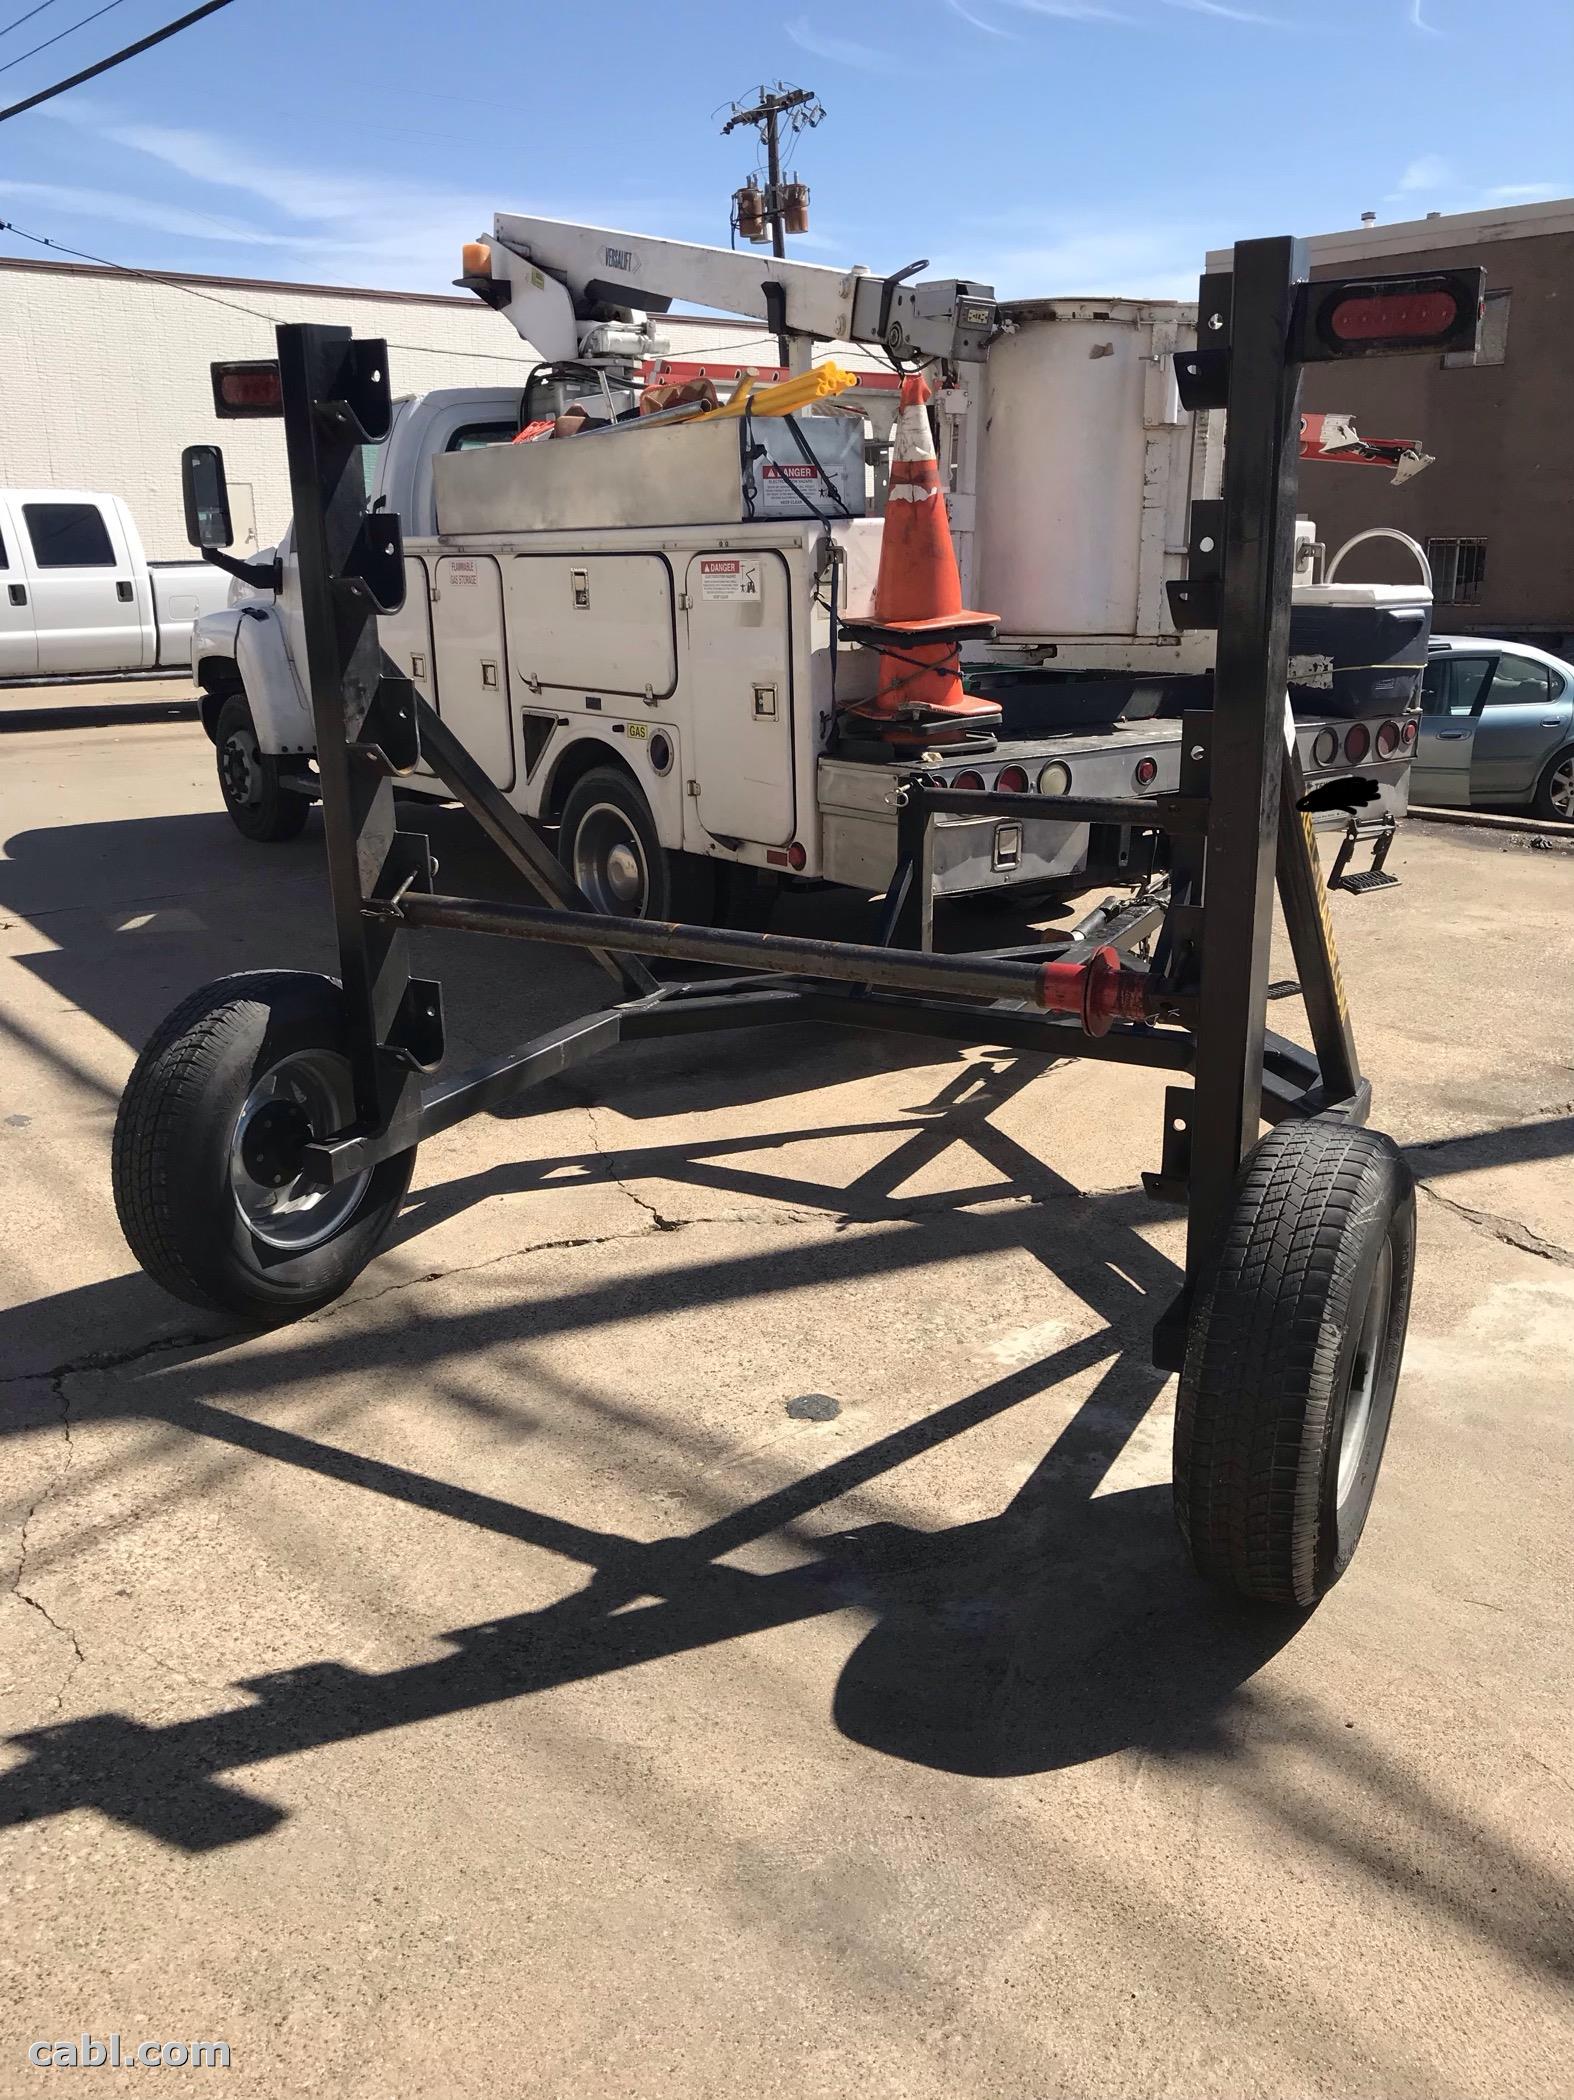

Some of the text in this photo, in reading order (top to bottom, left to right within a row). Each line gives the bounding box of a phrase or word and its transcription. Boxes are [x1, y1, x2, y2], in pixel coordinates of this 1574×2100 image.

[605, 247, 632, 272] VERSALIFT
[710, 563, 736, 572] DANGER
[629, 725, 646, 738] GAS
